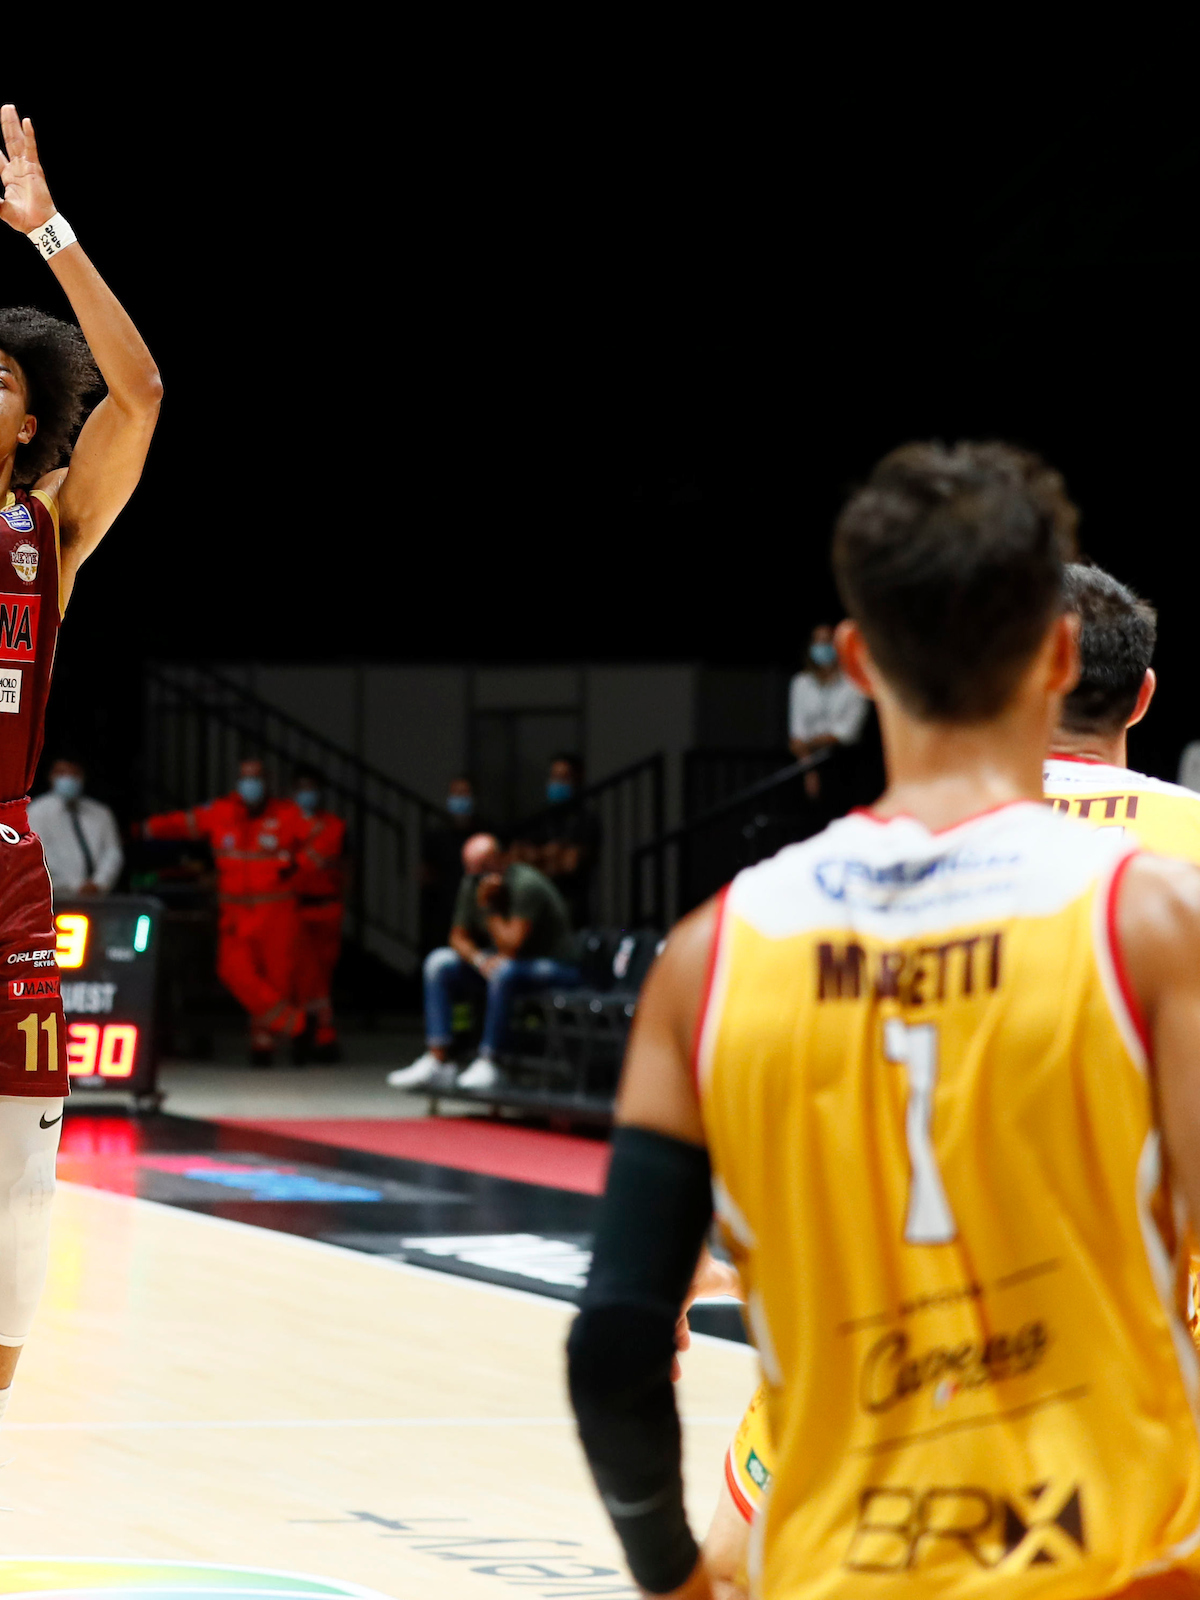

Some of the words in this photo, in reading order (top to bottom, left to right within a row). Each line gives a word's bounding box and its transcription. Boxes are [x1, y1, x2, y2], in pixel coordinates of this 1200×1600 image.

[9, 550, 39, 565] REYE
[818, 931, 1003, 1003] MRETTI
[61, 982, 118, 1014] UEST
[17, 1012, 59, 1072] 11
[67, 1022, 139, 1078] 30
[883, 1019, 958, 1245] 1
